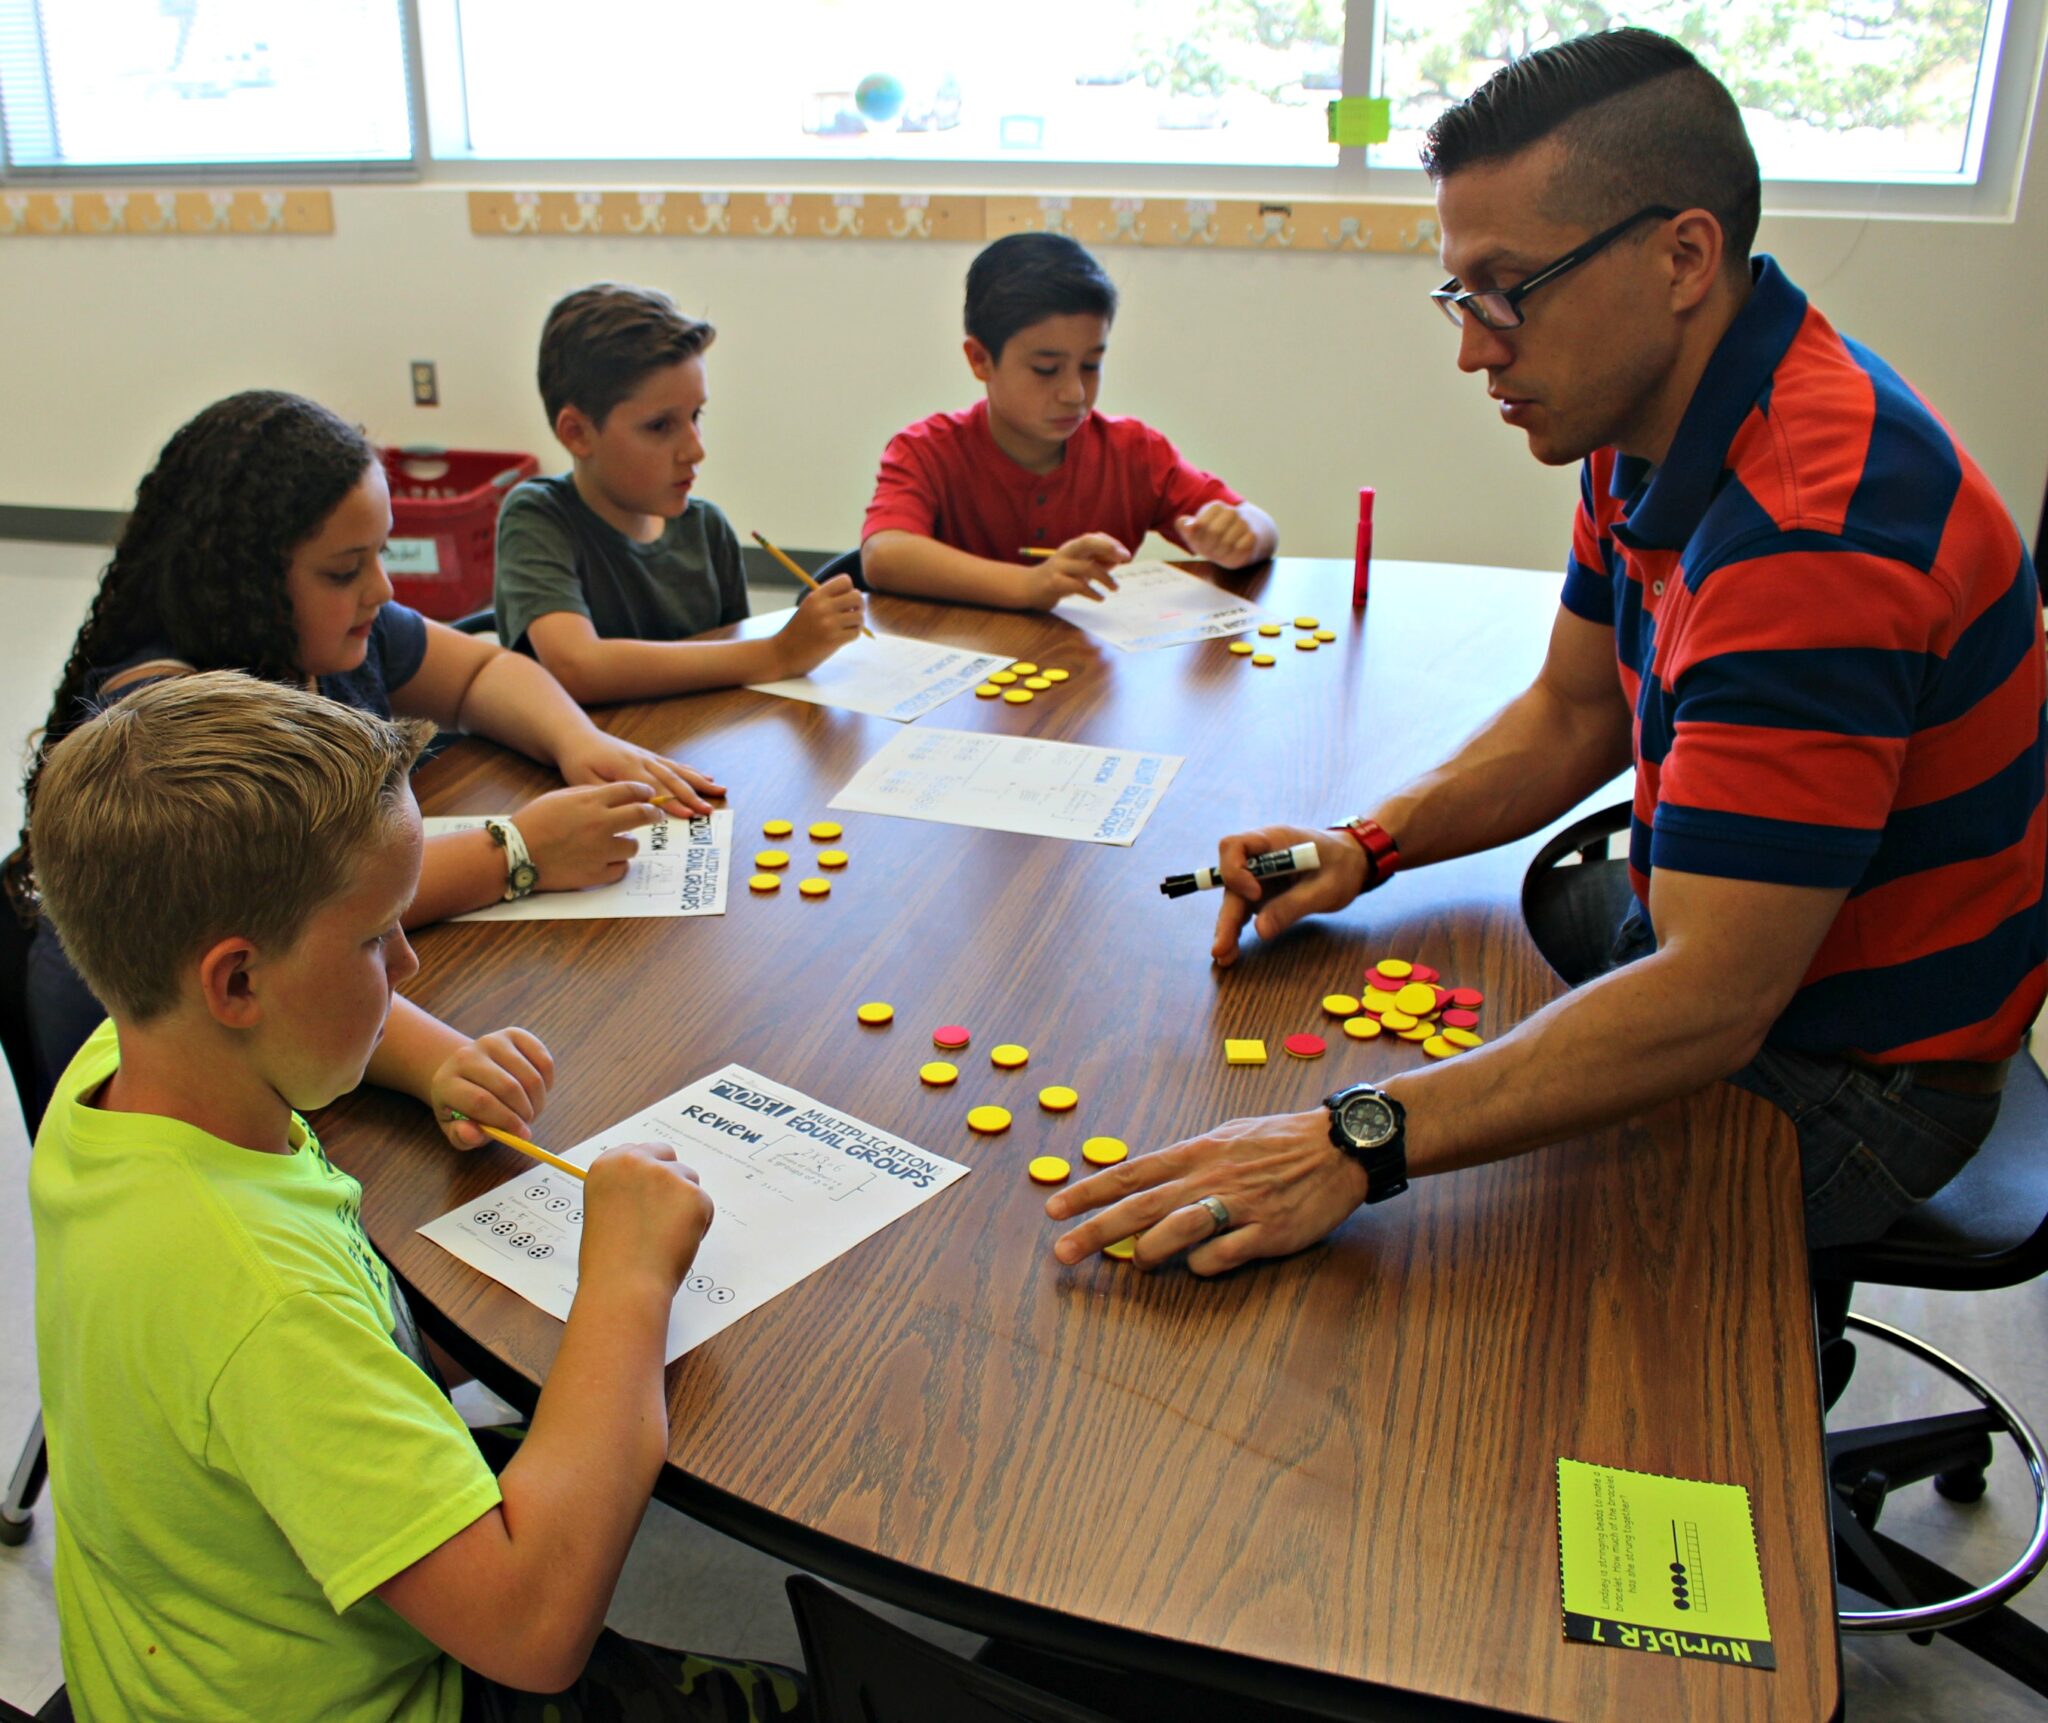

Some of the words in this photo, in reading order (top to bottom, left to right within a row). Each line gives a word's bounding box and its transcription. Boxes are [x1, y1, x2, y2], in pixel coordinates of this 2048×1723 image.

[681, 873, 702, 910] GROUPS
[786, 1115, 842, 1150] EQUAL
[845, 1143, 936, 1188] GROUPS
[801, 1108, 939, 1174] MULTIPLICATION
[1604, 1474, 1616, 1507] bracelet
[1594, 1508, 1605, 1532] beads
[1607, 1507, 1617, 1521] the
[1608, 1520, 1618, 1531] of
[1609, 1532, 1620, 1554] much
[1622, 1533, 1637, 1561] strung
[1611, 1554, 1621, 1573] How
[1624, 1562, 1636, 1579] she
[1600, 1577, 1612, 1610] Lindsey
[1626, 1579, 1637, 1594] has
